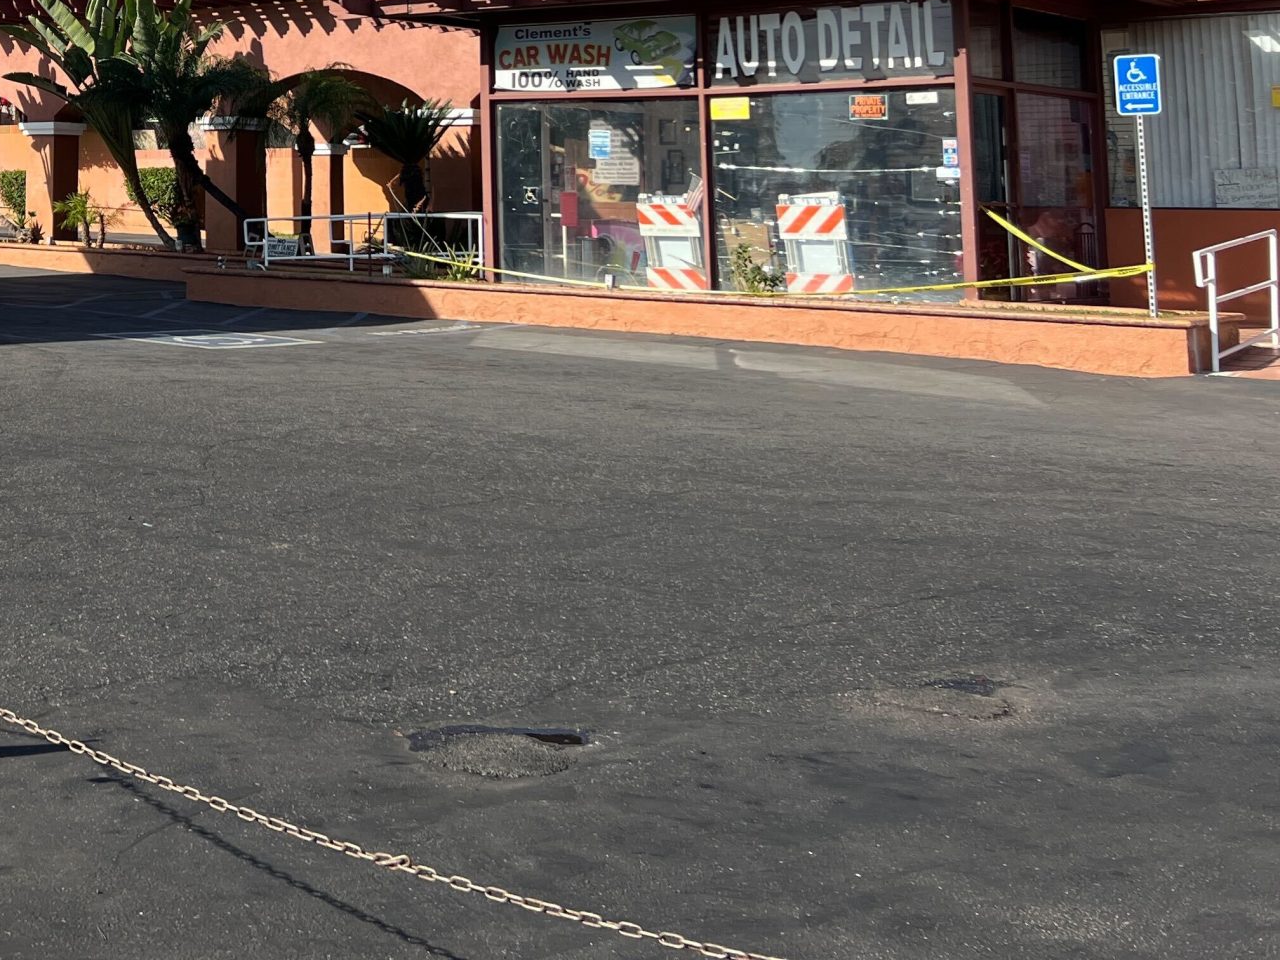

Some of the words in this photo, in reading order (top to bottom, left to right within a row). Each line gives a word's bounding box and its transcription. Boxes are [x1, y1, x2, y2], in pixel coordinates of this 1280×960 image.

[514, 25, 591, 40] Clement's
[715, 10, 805, 78] AUTO
[498, 45, 540, 70] CAR
[546, 43, 611, 67] WASH
[566, 69, 600, 78] HAND
[511, 71, 563, 89] 100%
[565, 78, 601, 88] WASH
[1119, 83, 1157, 91] ACCESSIBLE
[1122, 91, 1155, 100] ENTRANCE
[854, 96, 882, 105] PRIVATE
[851, 105, 885, 114] PROPERTY
